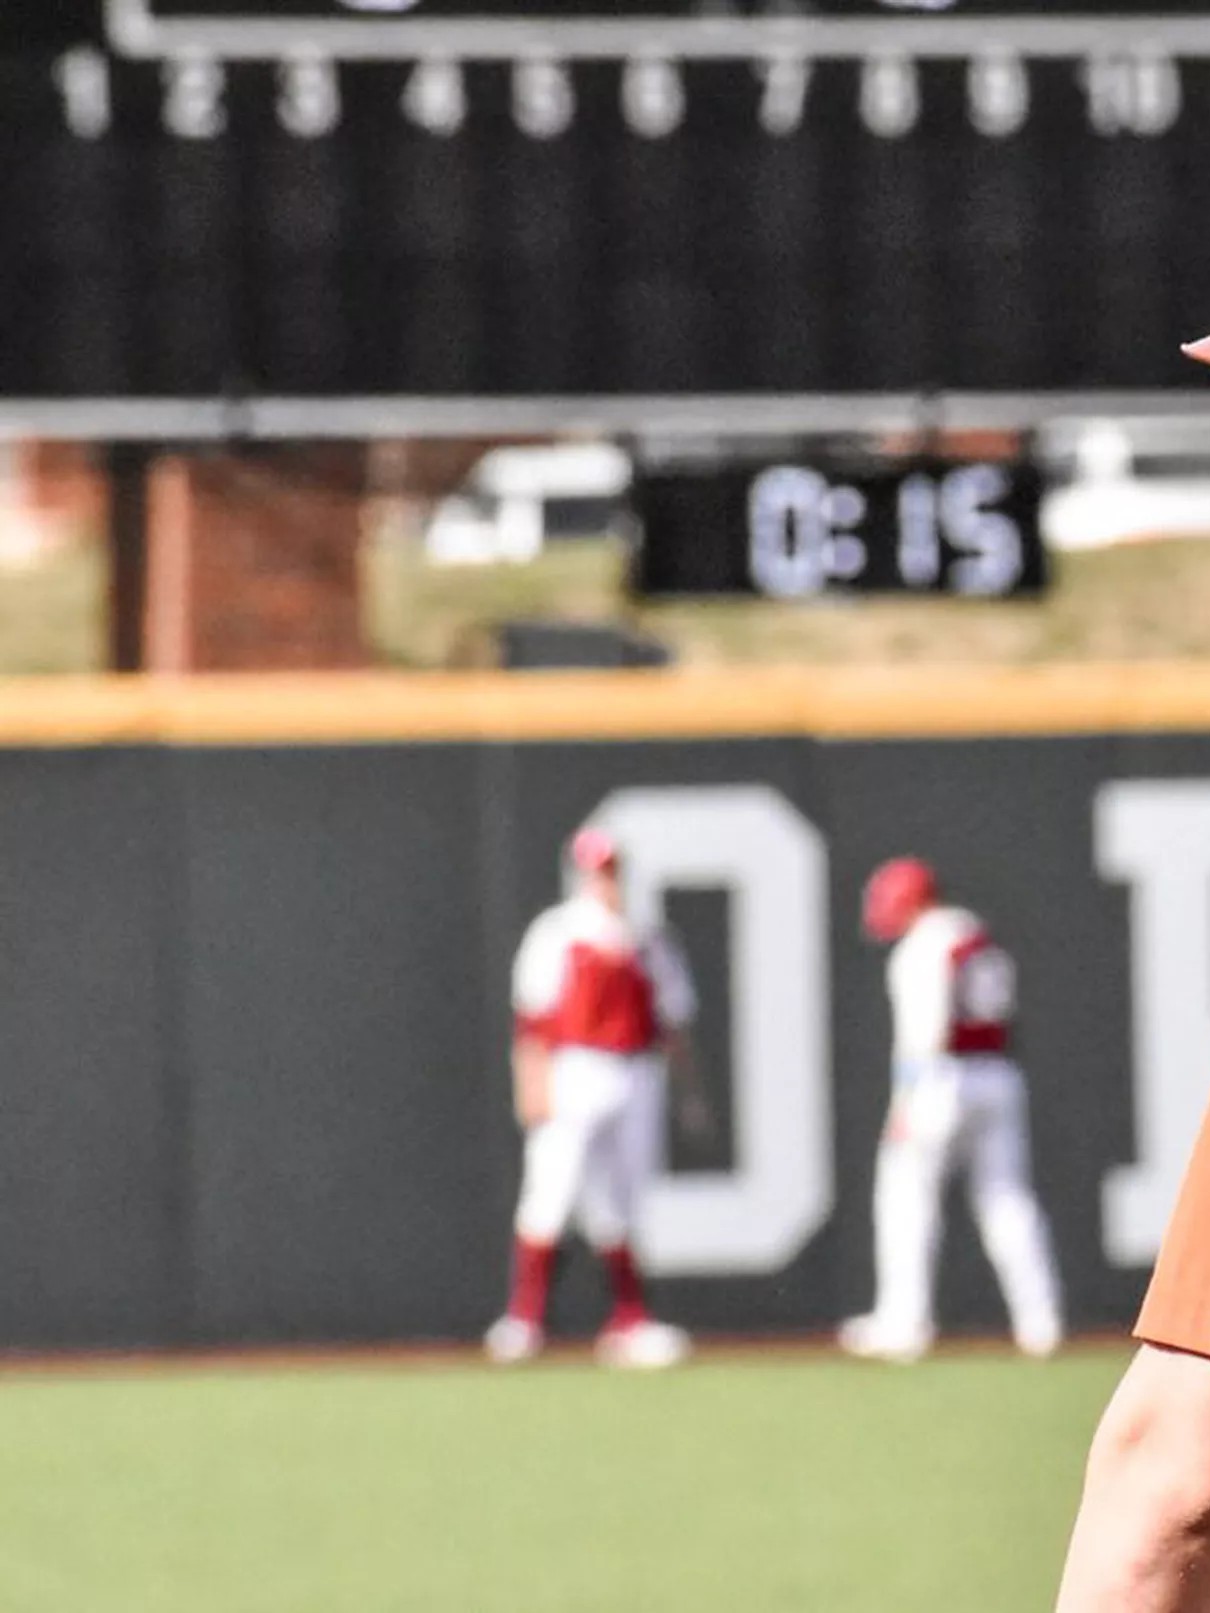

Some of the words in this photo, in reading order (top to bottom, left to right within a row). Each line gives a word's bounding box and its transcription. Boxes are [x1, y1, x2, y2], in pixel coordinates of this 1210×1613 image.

[54, 46, 110, 138] 1
[160, 46, 226, 138] 2
[277, 44, 340, 138] 3
[402, 46, 466, 136] 4
[511, 46, 574, 138] 5
[621, 46, 685, 138] 6
[752, 44, 812, 136] 7
[858, 45, 920, 136] 8
[966, 45, 1029, 136] 9
[1079, 45, 1180, 136] 10
